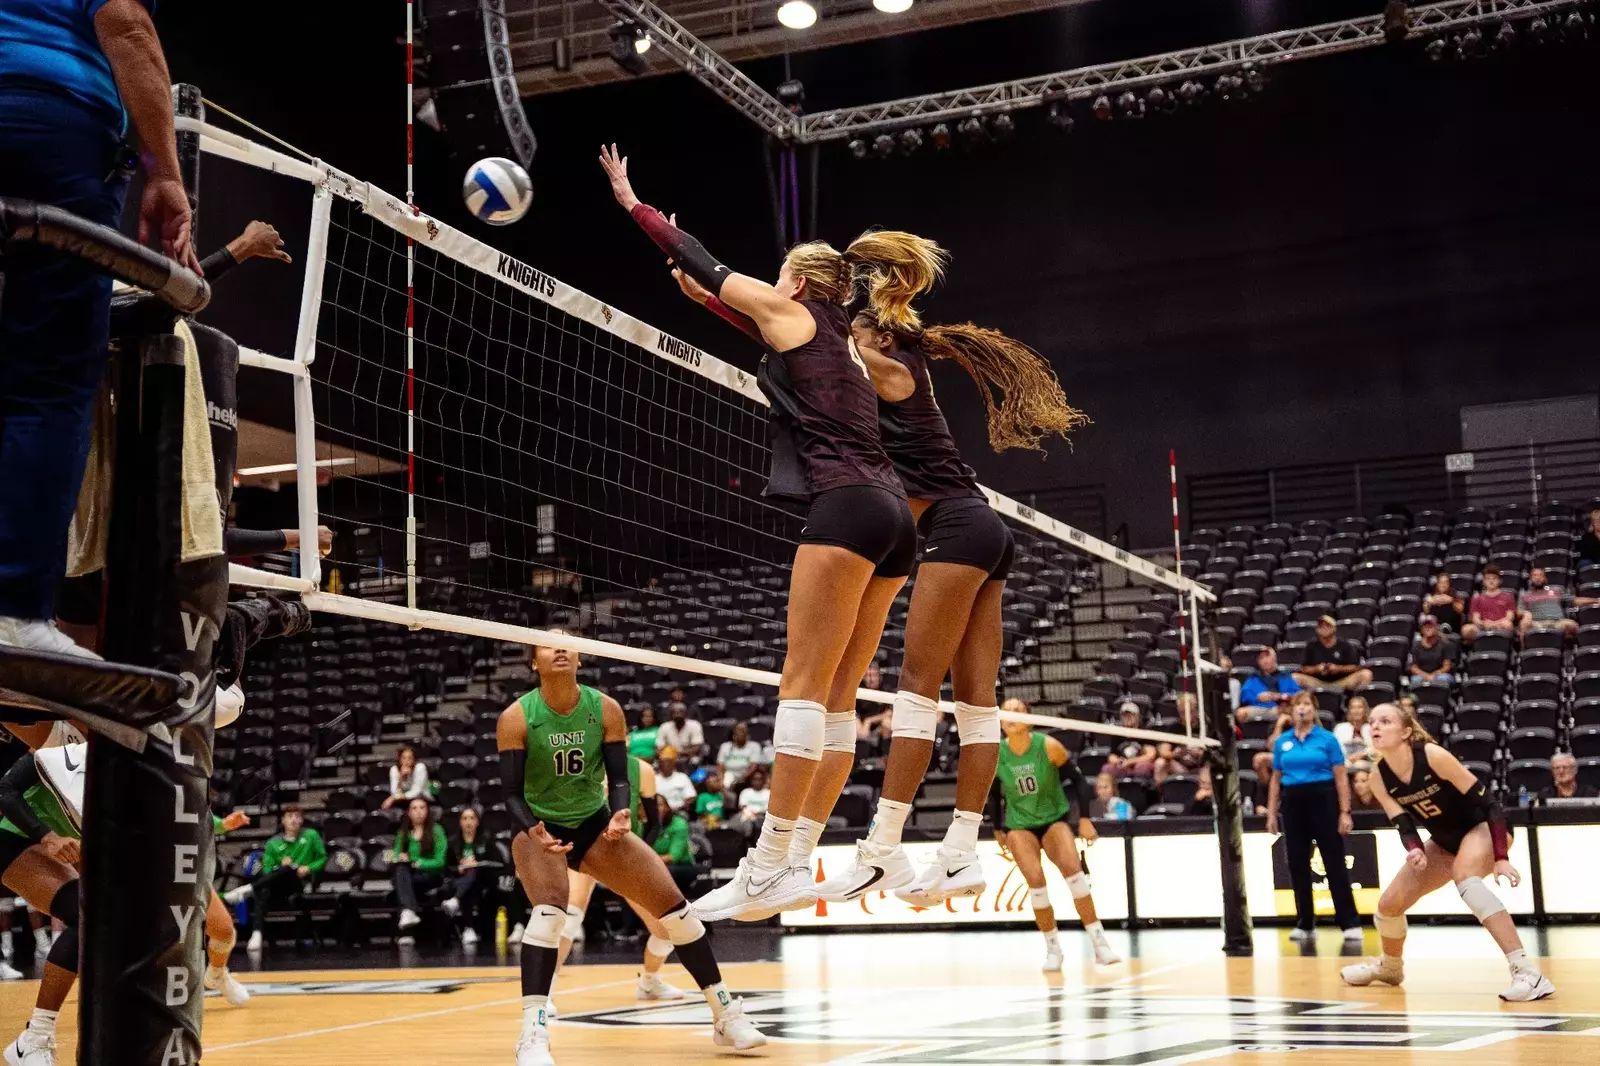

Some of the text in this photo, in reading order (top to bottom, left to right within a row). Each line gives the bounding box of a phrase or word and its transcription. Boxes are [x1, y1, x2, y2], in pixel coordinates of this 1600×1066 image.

[497, 252, 557, 298] KNIGHTS
[657, 331, 703, 368] KNIGHTS
[548, 730, 586, 747] UNT
[553, 747, 585, 776] 16
[1016, 774, 1038, 796] 10
[1412, 799, 1442, 819] 15
